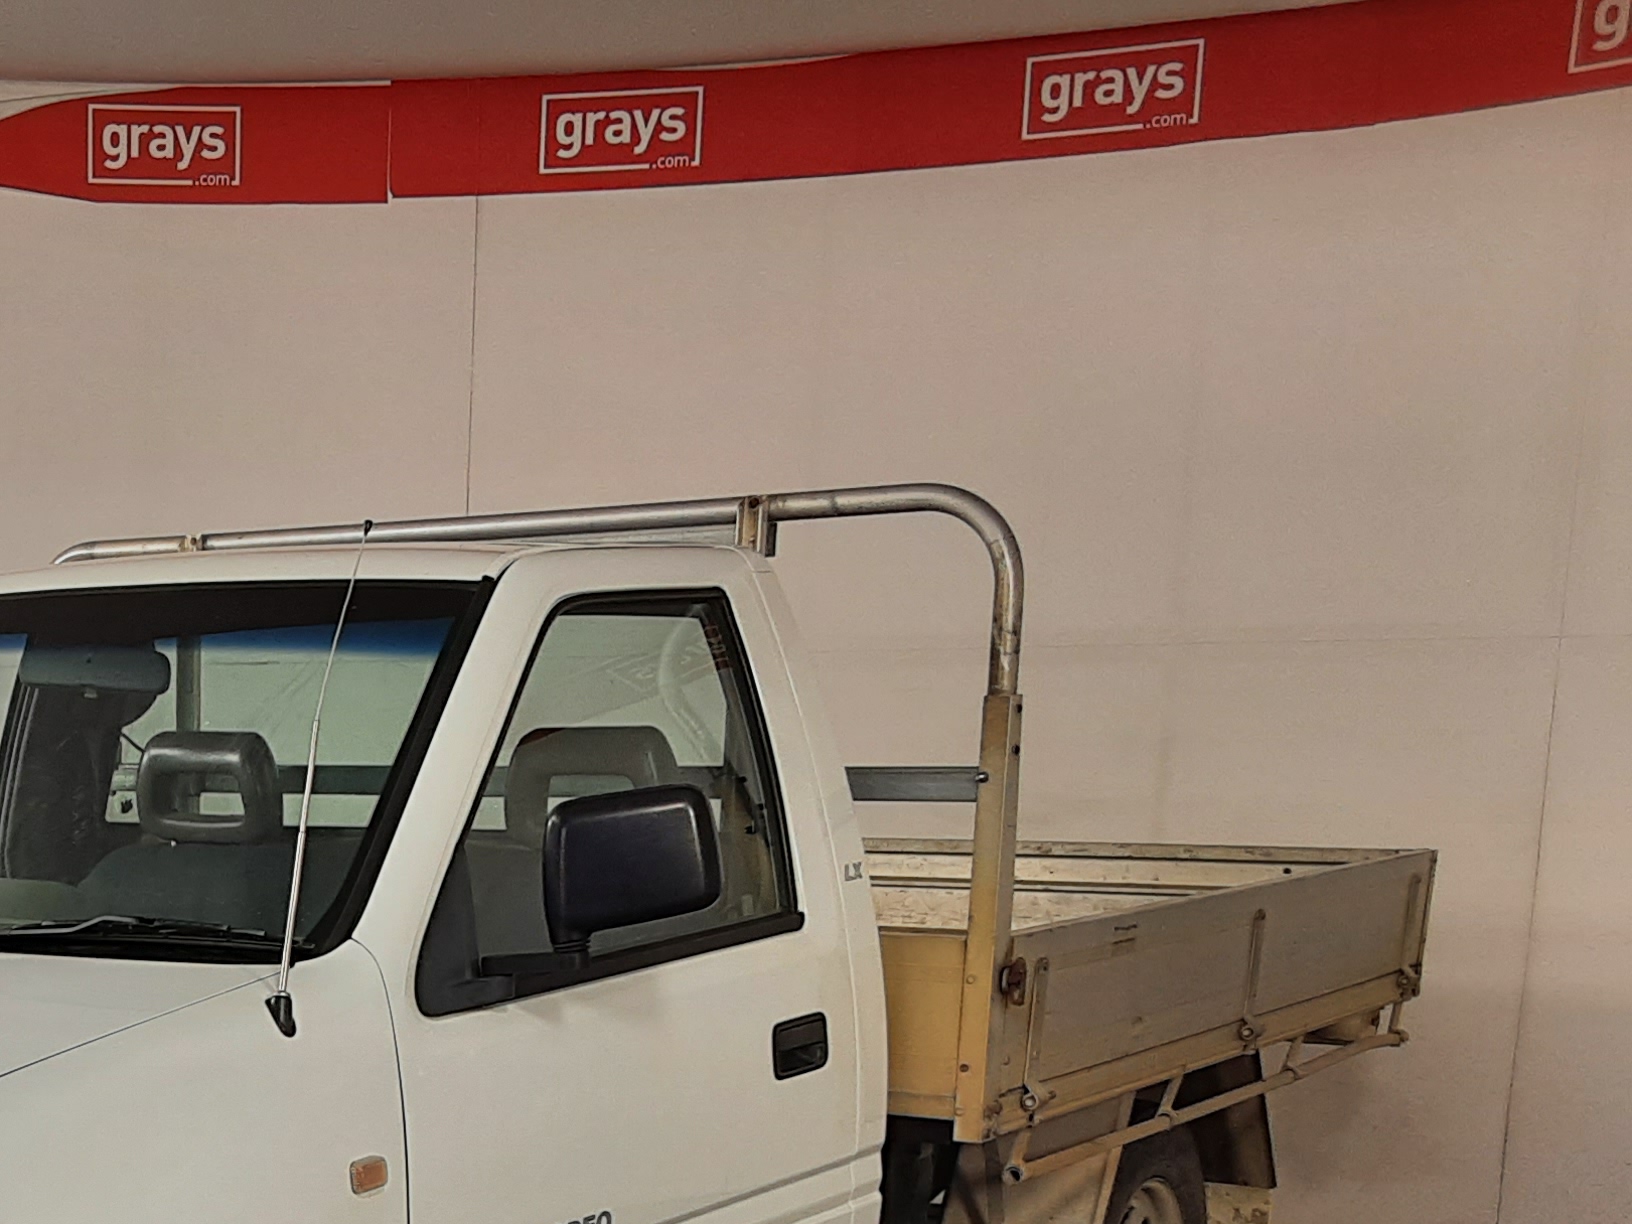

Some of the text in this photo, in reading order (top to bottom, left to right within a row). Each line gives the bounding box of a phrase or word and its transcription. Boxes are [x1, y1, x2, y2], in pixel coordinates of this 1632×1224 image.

[1040, 61, 1185, 123] grays
[1145, 112, 1187, 129] .com
[555, 106, 687, 159] grays
[101, 122, 227, 171] grays
[651, 155, 689, 169] .com
[194, 174, 230, 186] .com
[844, 861, 864, 882] LX
